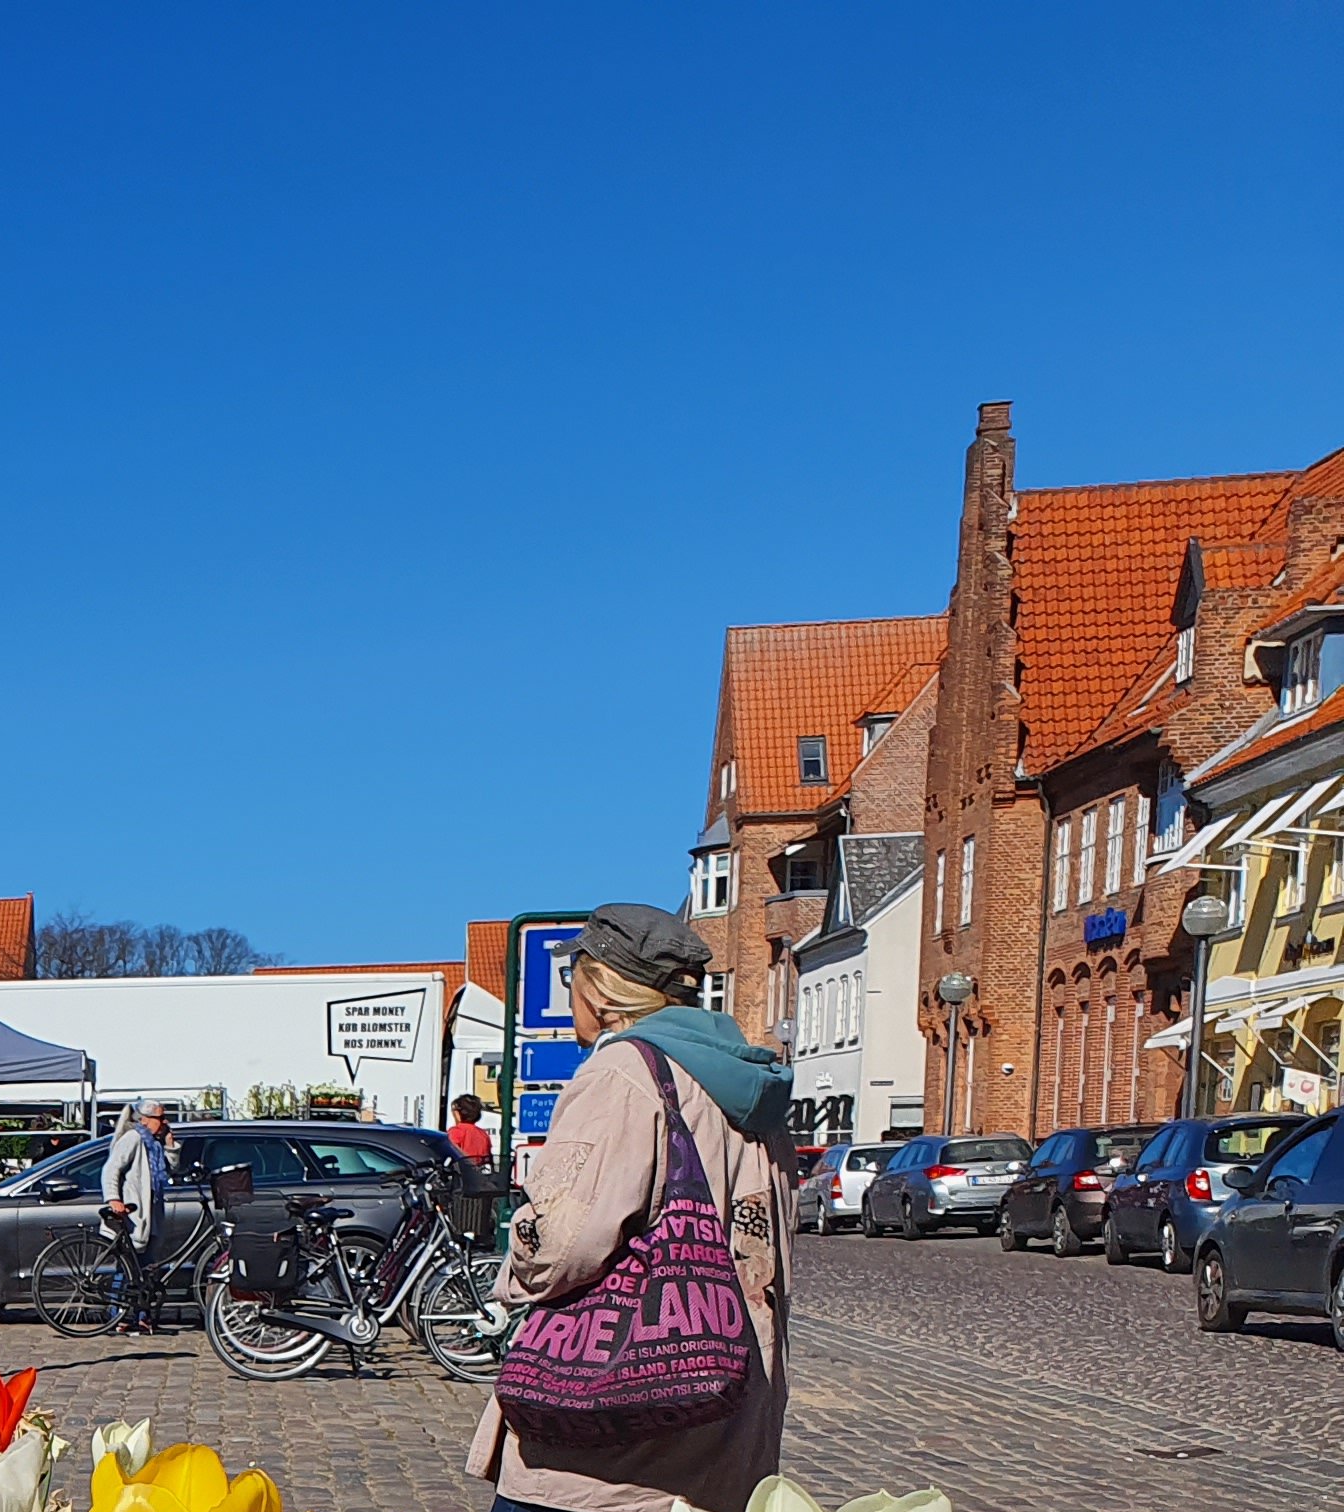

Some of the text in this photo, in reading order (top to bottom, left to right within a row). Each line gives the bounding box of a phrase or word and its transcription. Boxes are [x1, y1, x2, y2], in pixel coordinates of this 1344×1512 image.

[345, 1006, 406, 1016] SPAR MONEY
[360, 1023, 411, 1032] BLOMSTER
[344, 1039, 363, 1048] HOS
[531, 1098, 554, 1107] Park
[668, 1243, 730, 1266] FAROE
[638, 1343, 679, 1359] ISLAND
[617, 1361, 667, 1380] ISLAND
[670, 1355, 717, 1373] FAROE
